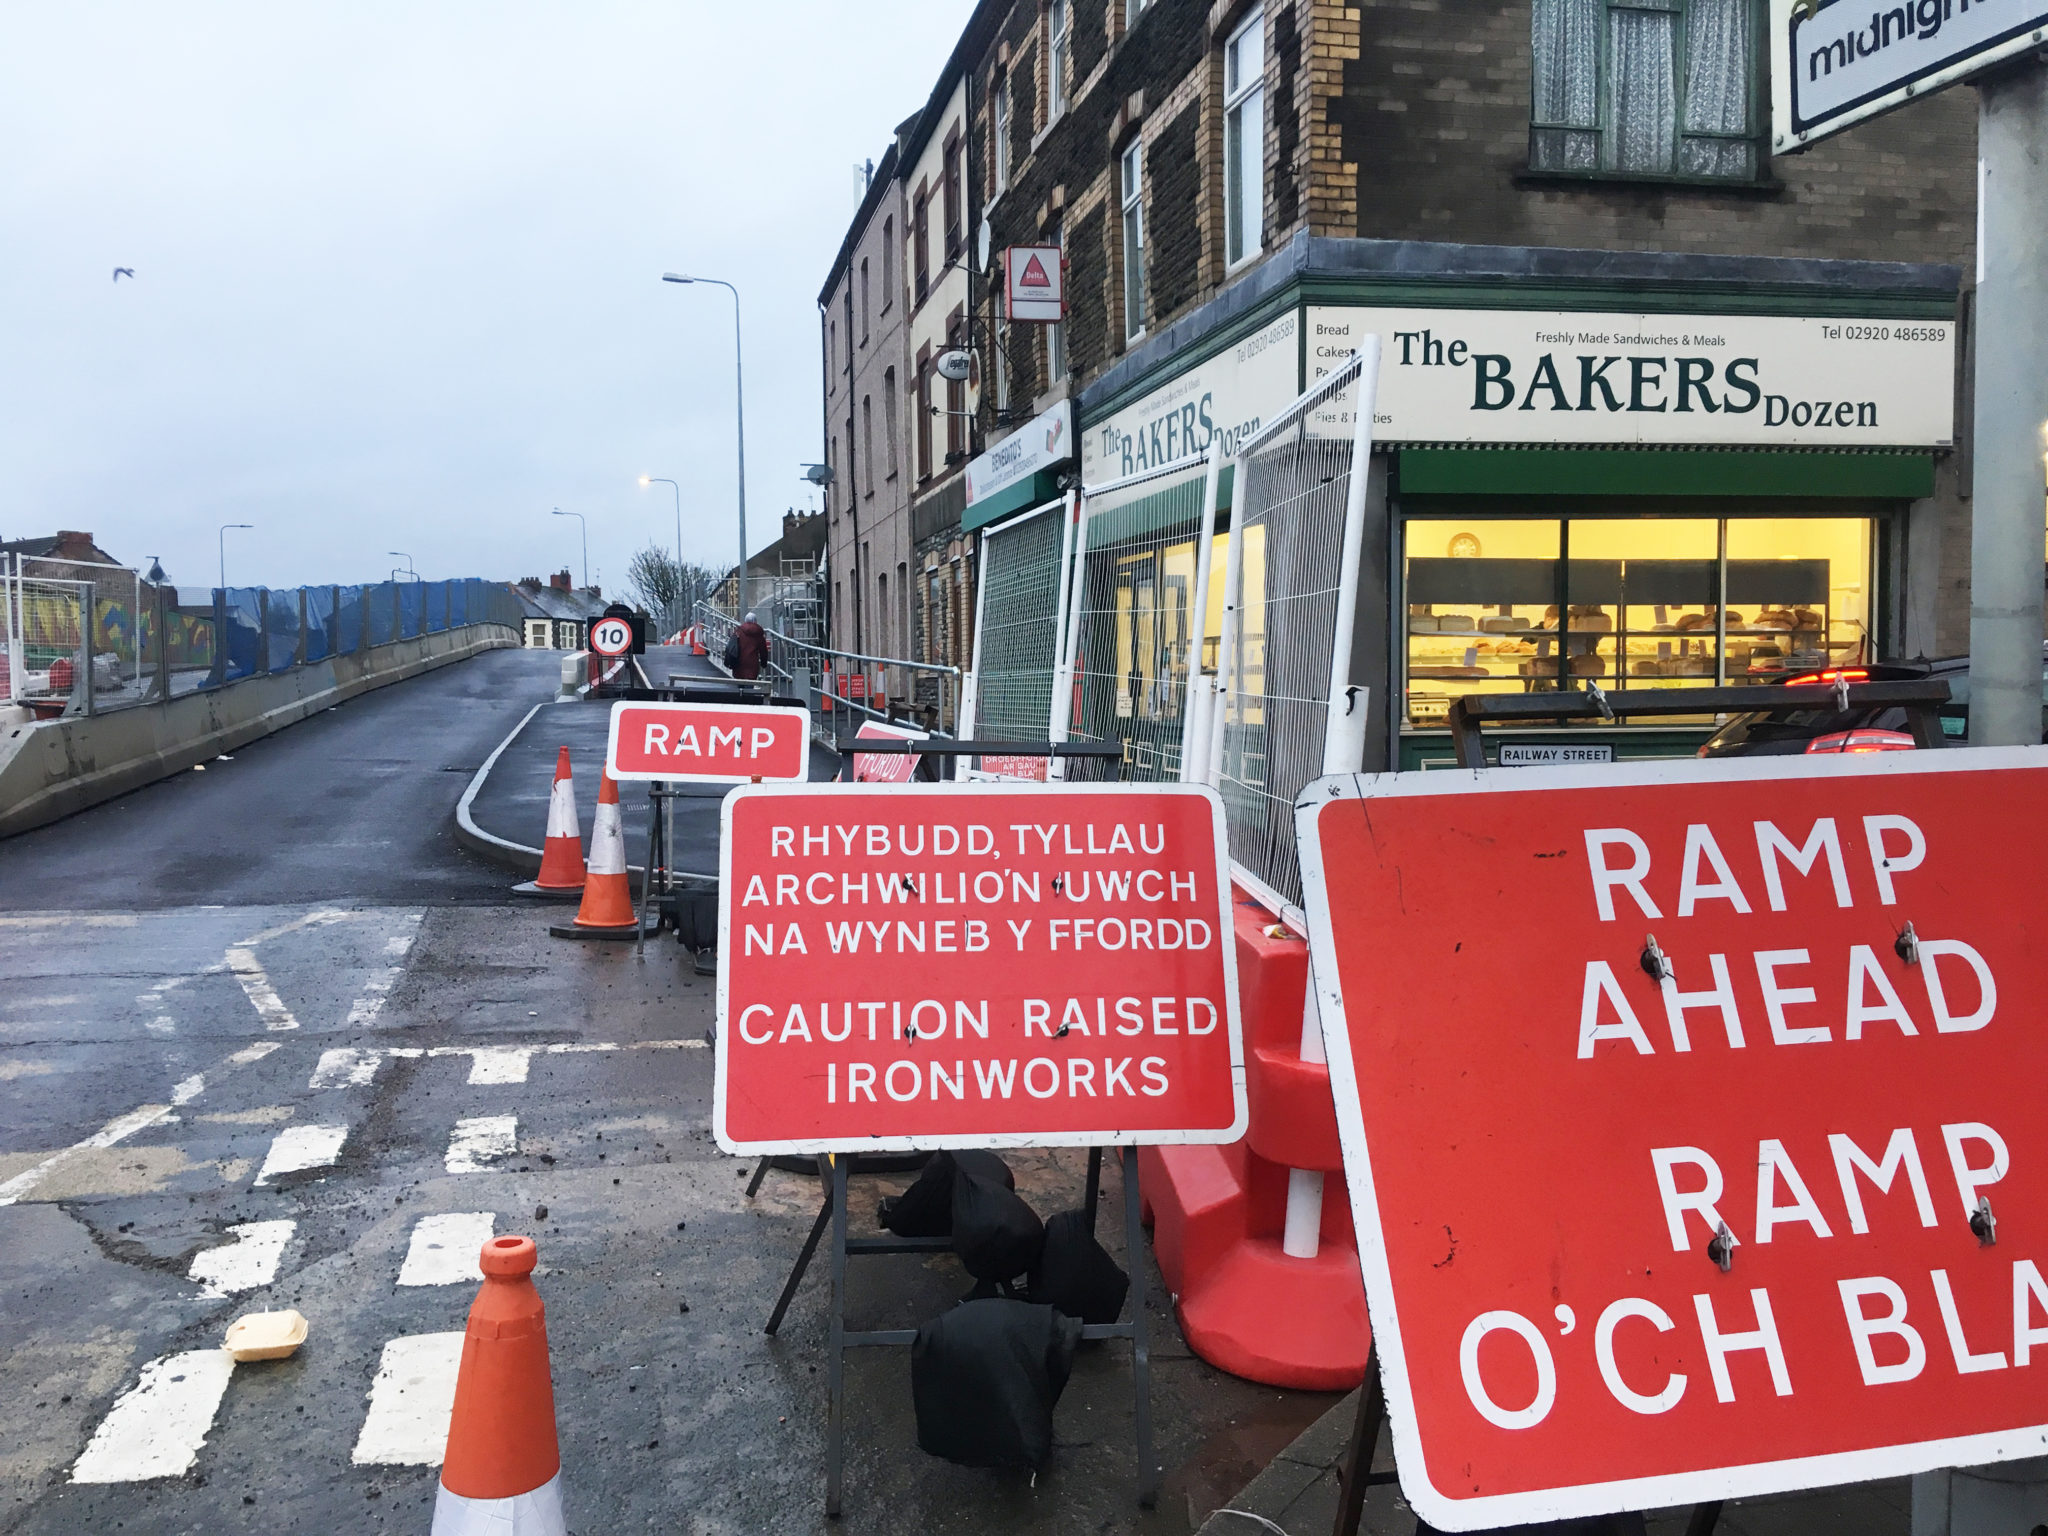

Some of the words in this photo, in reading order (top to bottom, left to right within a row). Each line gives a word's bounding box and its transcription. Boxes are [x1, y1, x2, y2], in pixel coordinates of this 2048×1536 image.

[1809, 0, 1987, 82] midnig
[1026, 271, 1044, 279] Delta
[1247, 334, 1268, 358] 02920
[1268, 318, 1294, 344] 486589
[1316, 324, 1349, 336] Bread
[1535, 331, 1575, 346] Freshly
[1578, 332, 1610, 344] Made
[1613, 333, 1679, 346] Sandwiches
[1681, 335, 1690, 346] &
[1693, 335, 1726, 347] Meals
[1822, 325, 1841, 339] Tel
[1845, 326, 1890, 340] 02920
[1893, 327, 1946, 341] 486589
[1316, 346, 1350, 358] Cakes
[1393, 329, 1468, 367] The
[1470, 353, 1761, 413] BAKERS
[1763, 395, 1879, 428] Dozen
[1101, 424, 1121, 457] The
[1121, 391, 1213, 477] BAKERS
[1315, 412, 1337, 423] Pies
[600, 627, 624, 645] 10
[644, 723, 775, 759] RAMP
[1504, 750, 1558, 760] RAILWAY
[1562, 750, 1608, 760] STREET
[771, 824, 1001, 860] RHYBUDD,
[1009, 823, 1165, 855] TYLLAU
[741, 868, 1041, 907] ARCHWILIO'N
[1064, 869, 1197, 903] UWCH
[1583, 814, 1928, 922] RAMP
[744, 922, 808, 957] NA
[825, 920, 990, 954] WYNEB
[1006, 919, 1032, 952] Y
[1049, 917, 1212, 951] FFORDD
[1576, 939, 1998, 1060] AHEAD
[739, 1000, 989, 1045] CAUTION
[1023, 996, 1218, 1038] RAISED
[827, 1056, 1169, 1104] IRONWORKS
[1650, 1121, 2011, 1252] RAMP
[1459, 1287, 1795, 1430] O'CH
